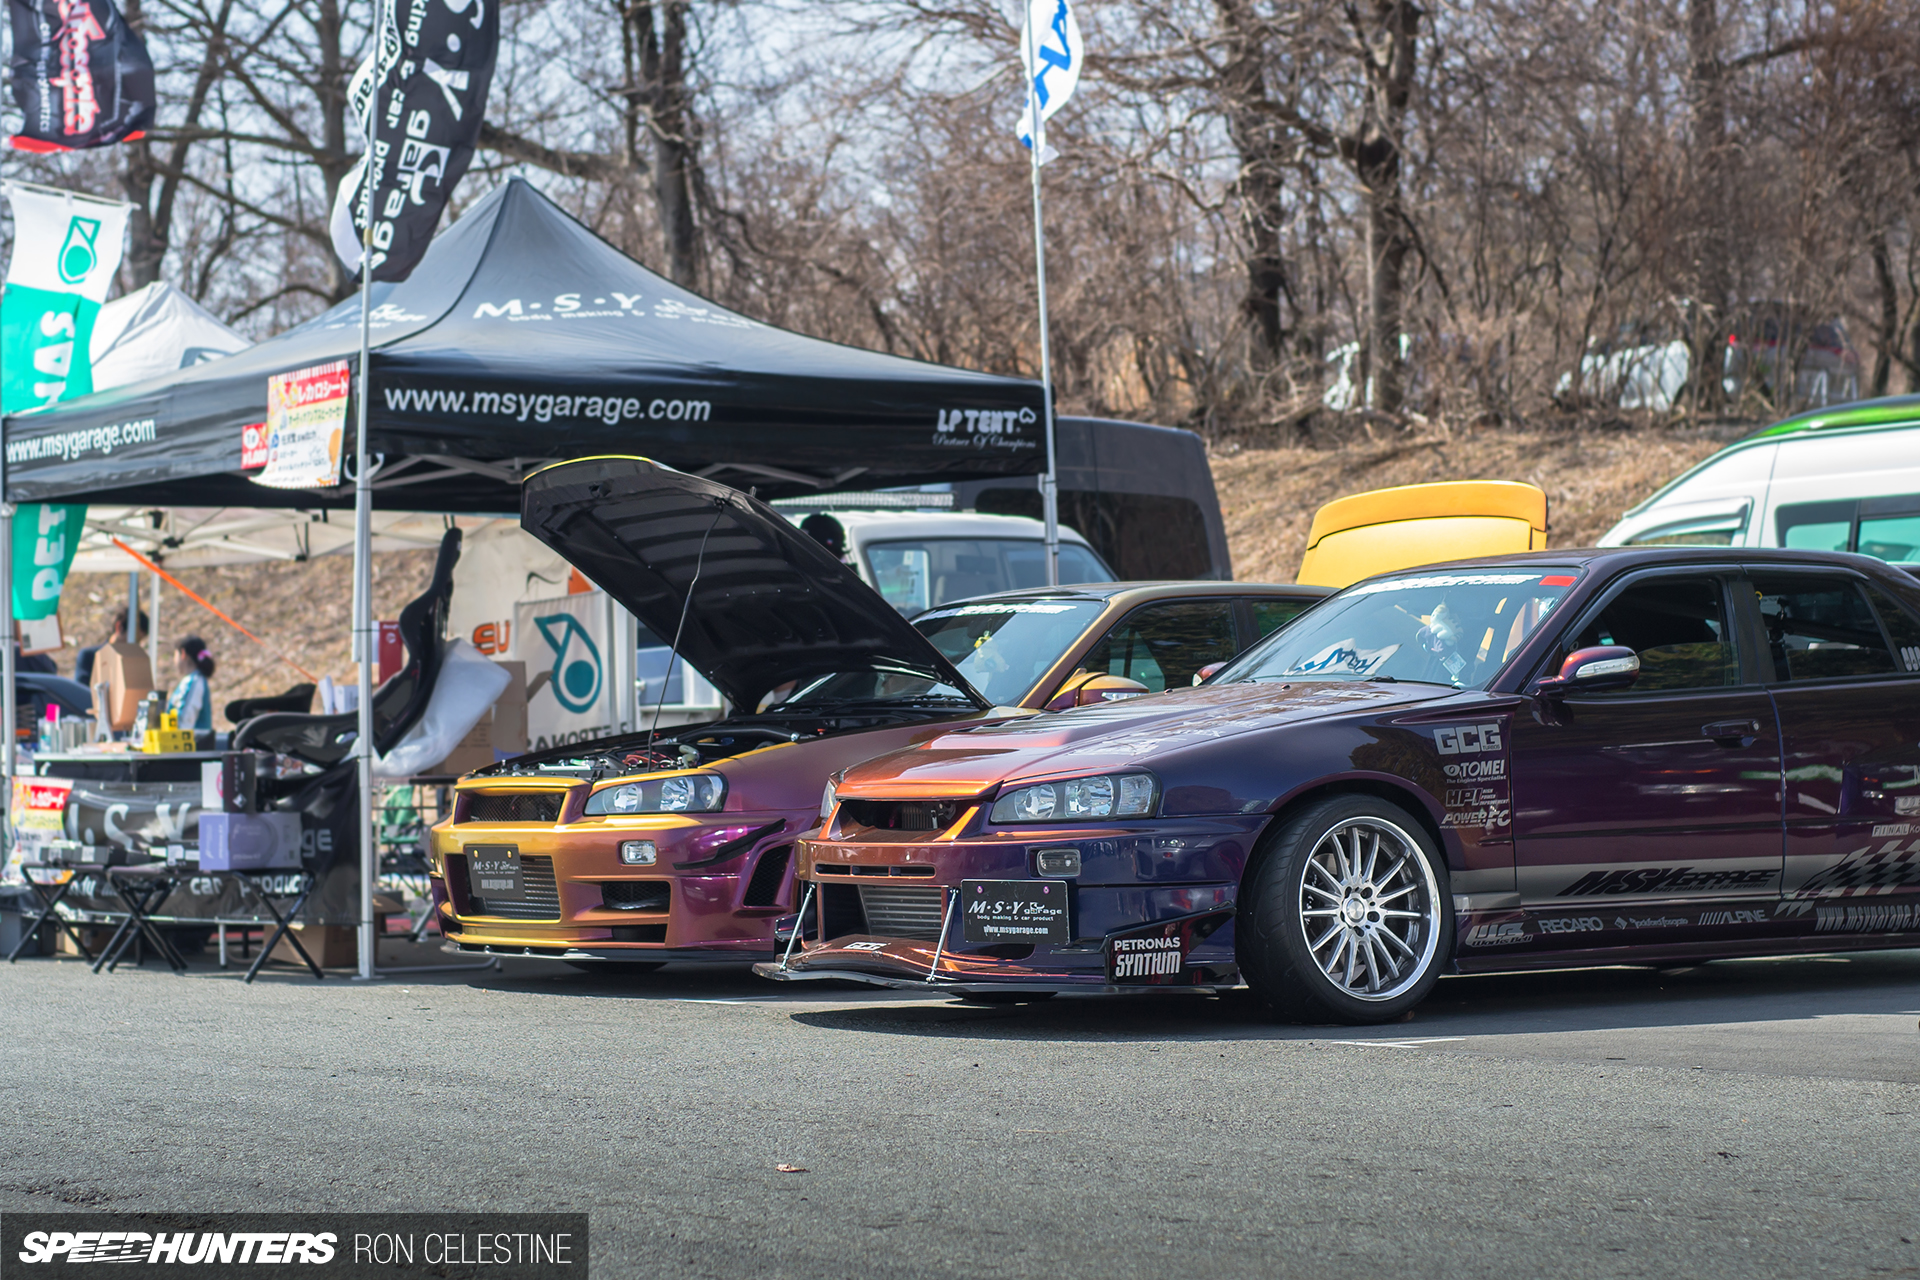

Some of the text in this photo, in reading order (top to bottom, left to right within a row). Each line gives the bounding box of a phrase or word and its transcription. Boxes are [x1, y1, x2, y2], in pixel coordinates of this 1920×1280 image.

[384, 387, 712, 426] www.msygarage.com
[5, 418, 156, 464] www.msygarage.com
[1432, 723, 1502, 755] GCG
[1460, 759, 1506, 777] TOMEI
[1445, 787, 1484, 807] HPI
[1441, 810, 1488, 826] POWER
[1872, 823, 1910, 837] FINAL
[1538, 916, 1604, 934] RECARO
[1719, 909, 1771, 925] ALPINE
[983, 924, 1049, 935] www.msygarage.com
[1114, 937, 1181, 951] PETRONAS
